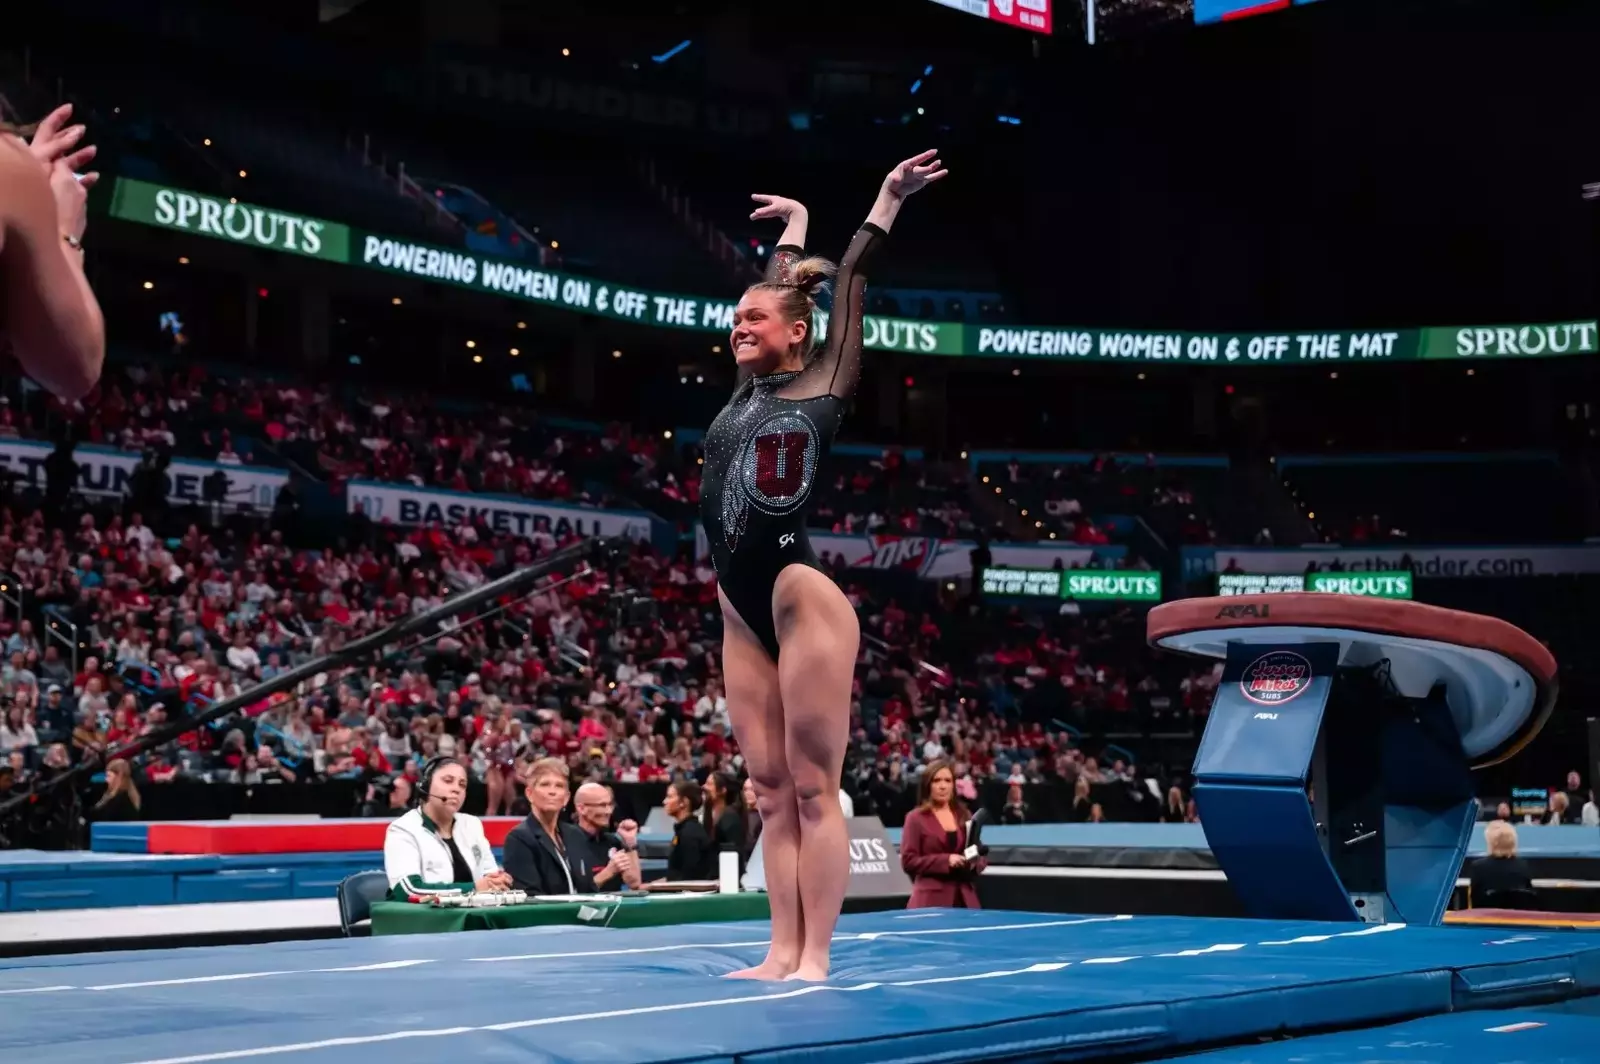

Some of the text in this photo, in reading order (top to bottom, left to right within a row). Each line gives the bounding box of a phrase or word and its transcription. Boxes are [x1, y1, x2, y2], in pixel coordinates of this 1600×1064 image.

[155, 189, 323, 253] SPROUTS
[364, 235, 737, 330] POWERING WOMEN ON & OFF THE MA
[863, 318, 939, 352] OUTS
[978, 328, 1399, 361] POWERING WOMEN ON & OFF THE MAT
[1456, 322, 1597, 356] SPROUT
[755, 431, 811, 498] U
[1069, 575, 1158, 595] SPROUTS
[1315, 577, 1408, 595] SPROUTS
[1252, 661, 1305, 678] Jersey
[1260, 692, 1282, 700] SUBS
